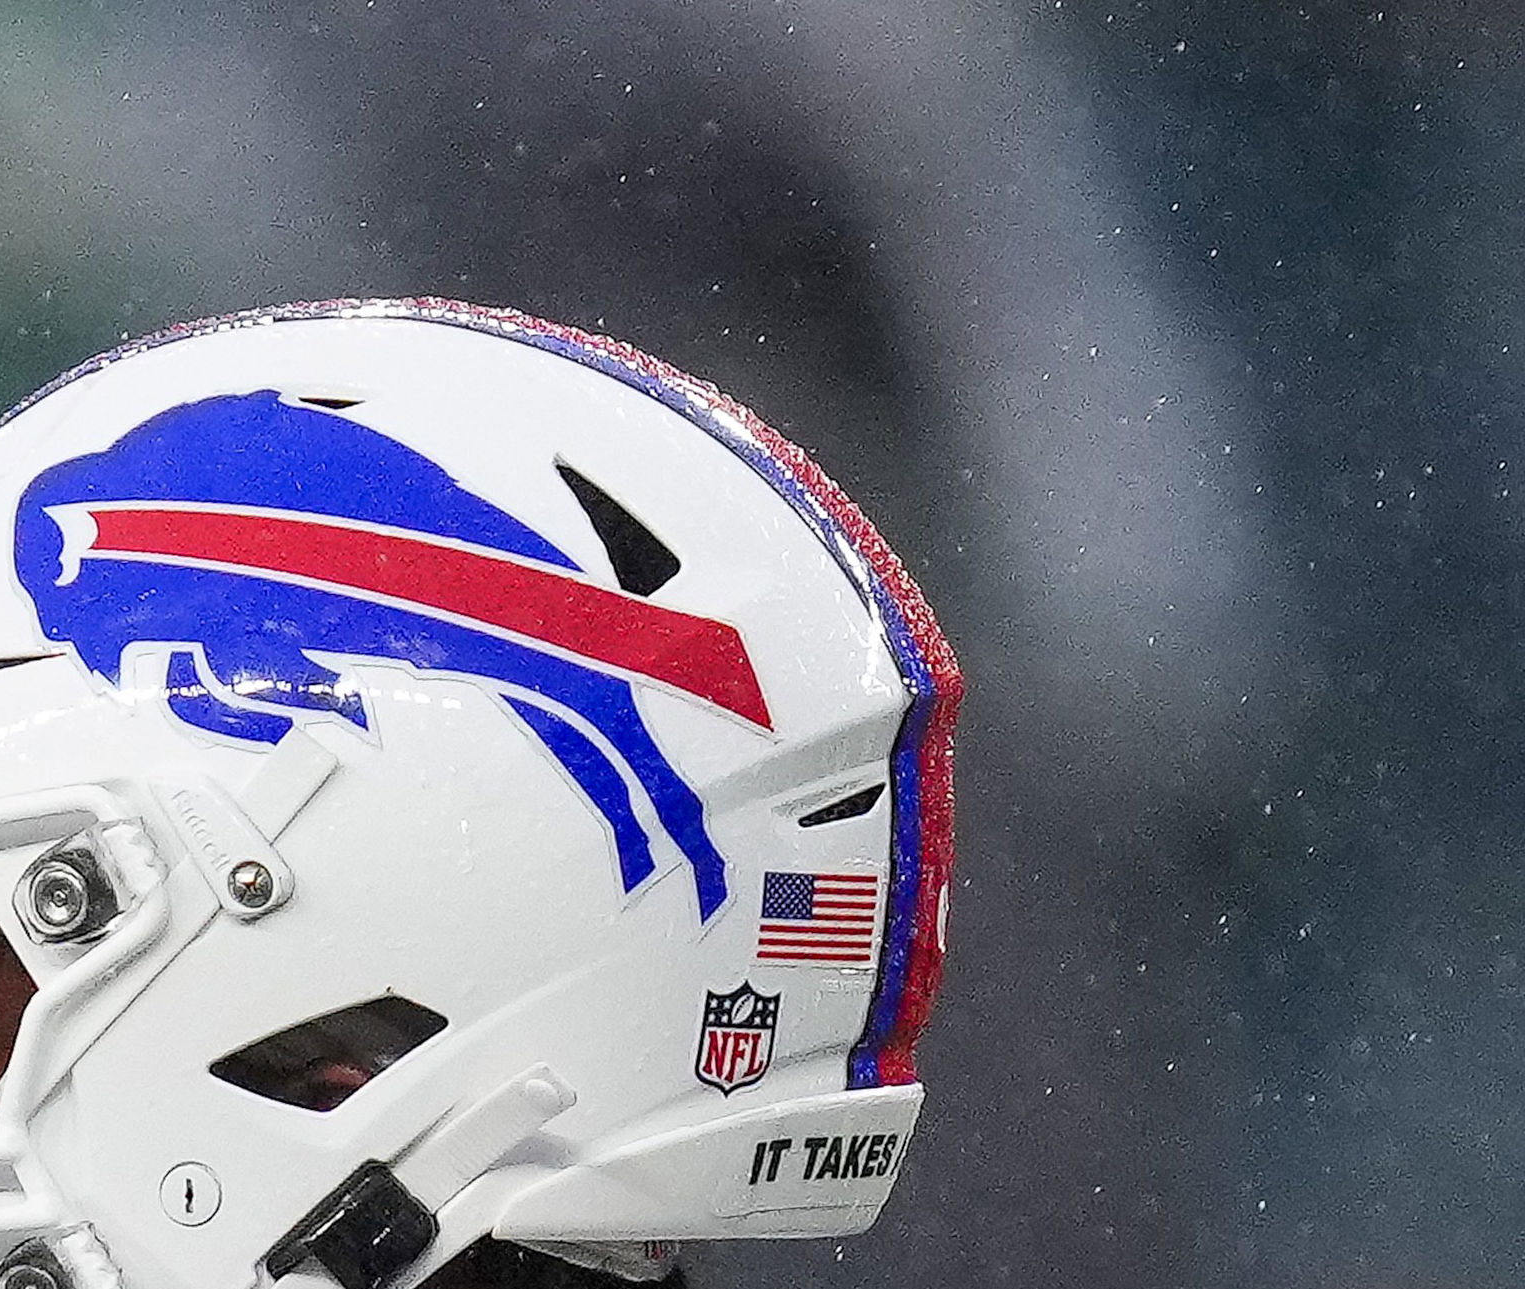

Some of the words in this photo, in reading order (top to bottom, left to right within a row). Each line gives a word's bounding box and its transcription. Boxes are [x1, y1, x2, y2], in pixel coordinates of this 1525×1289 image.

[702, 1030, 765, 1084] NFL
[749, 1138, 792, 1185] IT
[803, 1134, 899, 1180] TAKES
